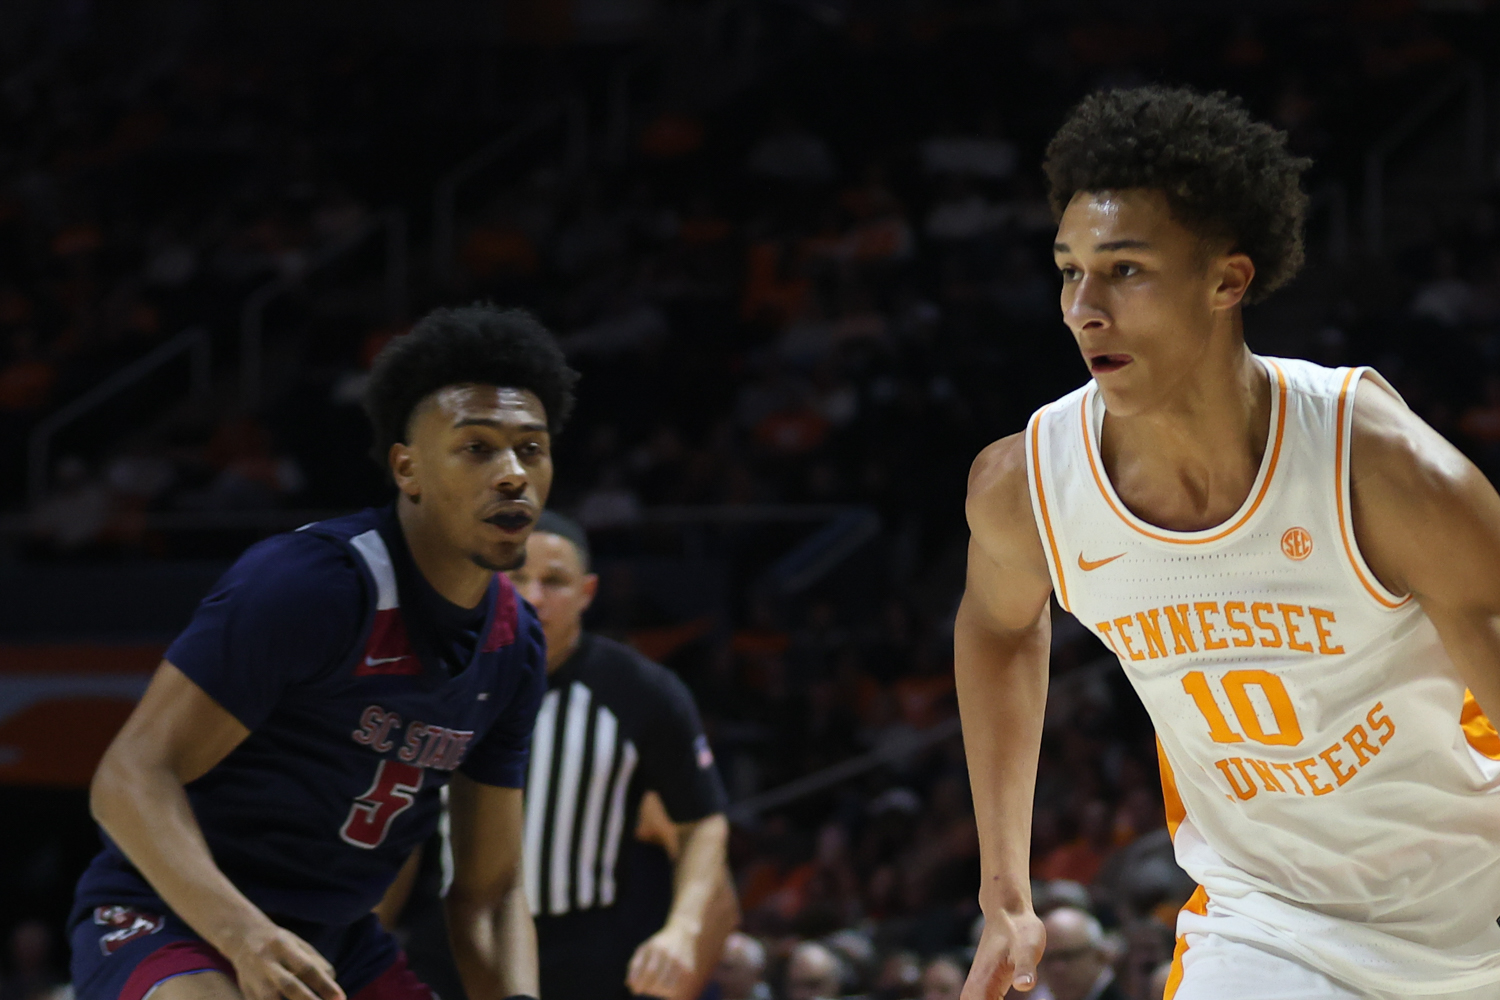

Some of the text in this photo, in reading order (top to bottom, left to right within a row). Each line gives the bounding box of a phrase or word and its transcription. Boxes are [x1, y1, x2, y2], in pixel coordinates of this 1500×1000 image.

[1282, 529, 1311, 559] SEC
[1095, 601, 1346, 662] TENNESSEE
[352, 705, 402, 753] SC
[1181, 669, 1304, 747] 10
[1215, 701, 1396, 804] UNTEERS
[340, 759, 425, 850] 5
